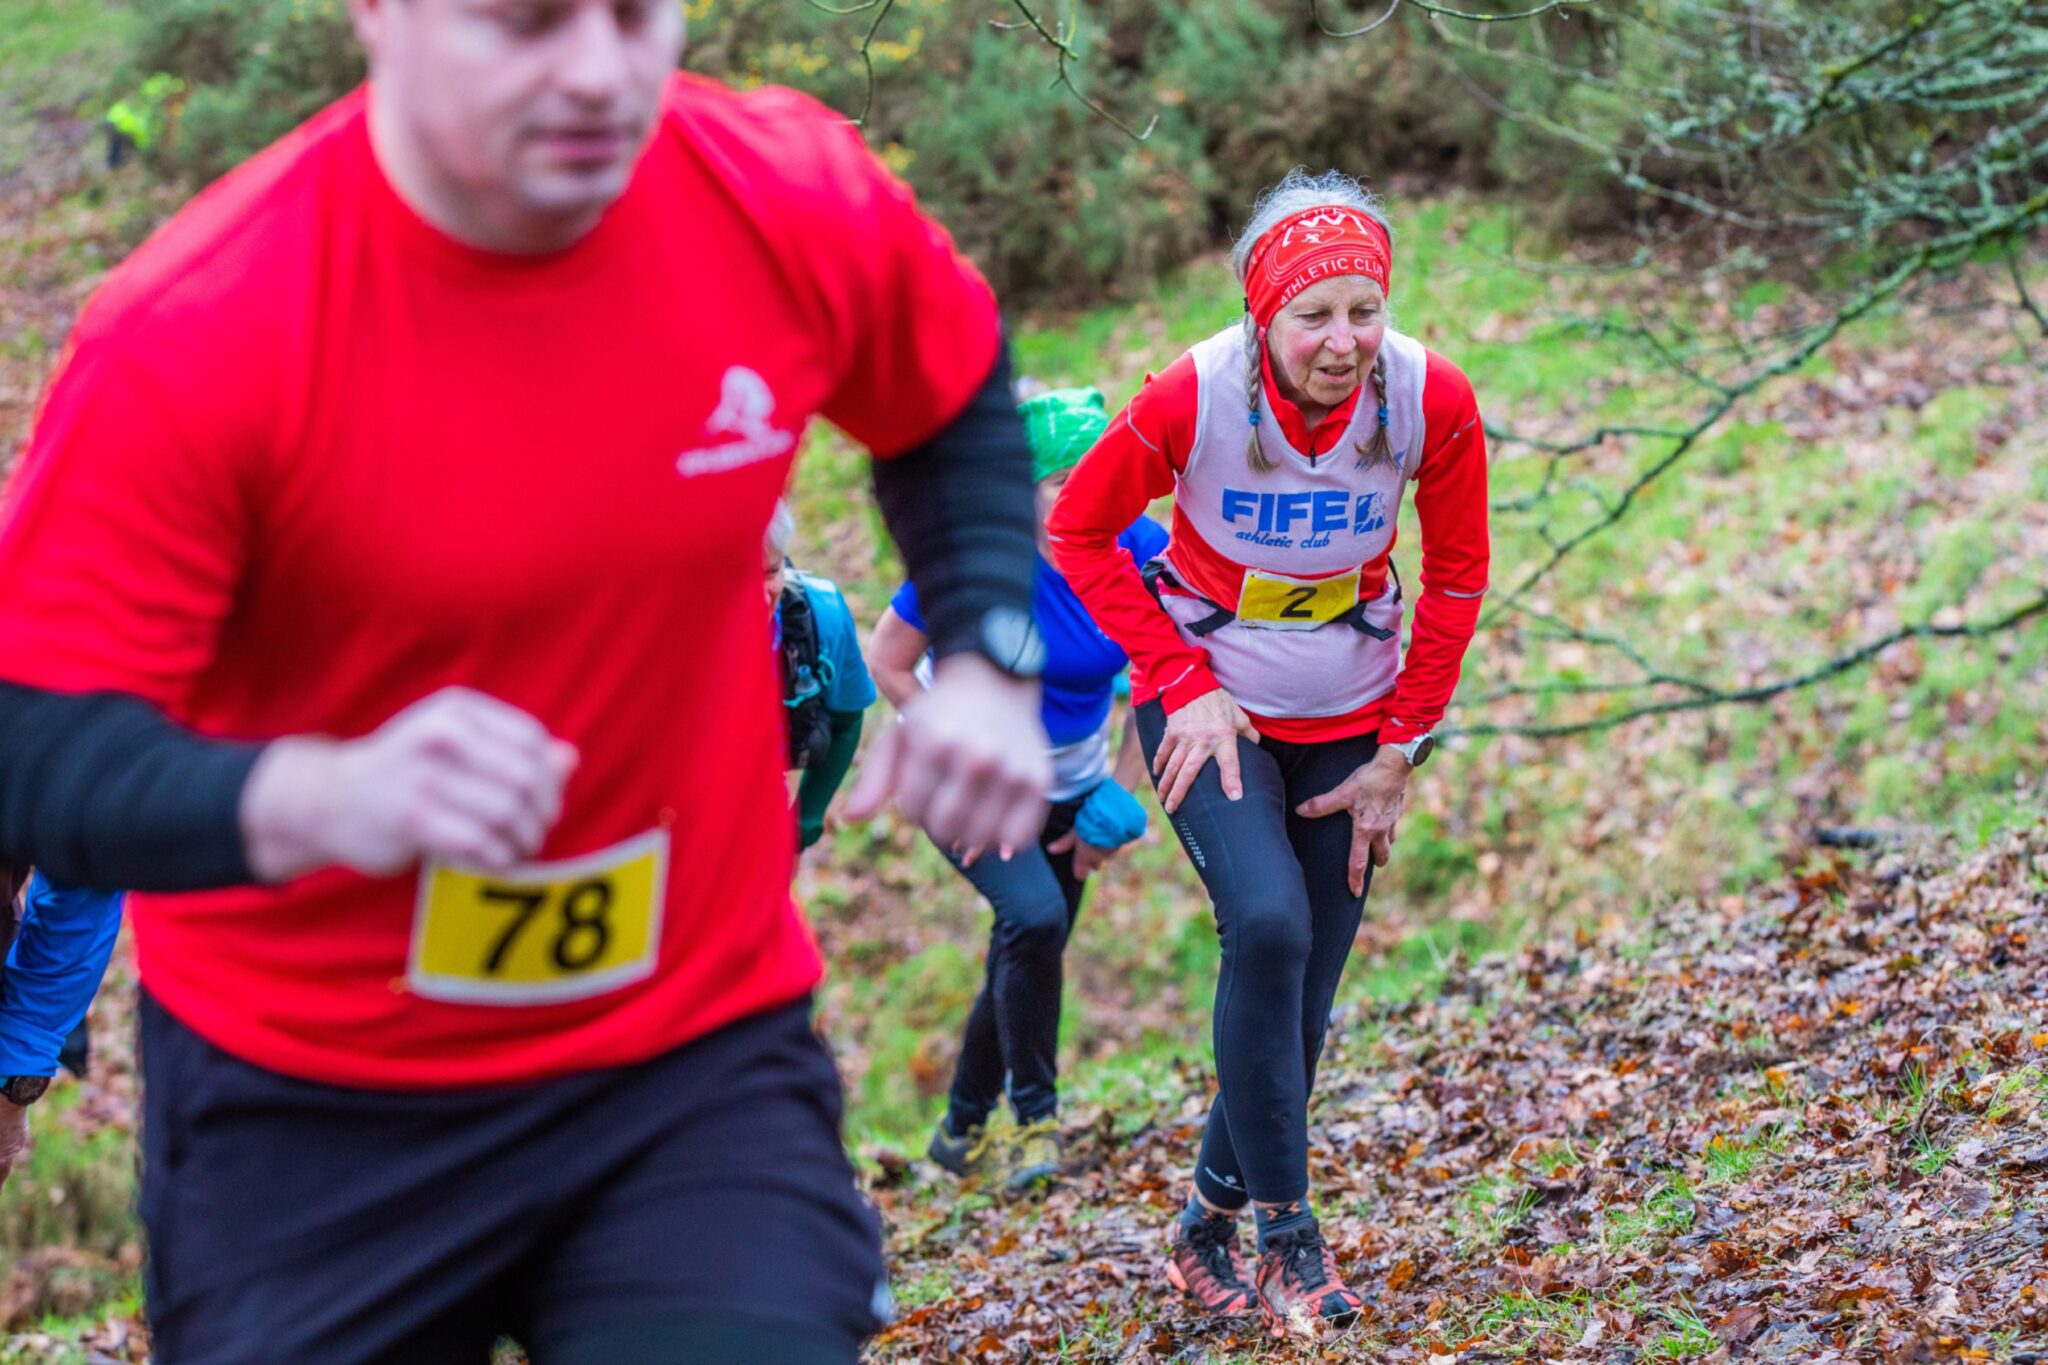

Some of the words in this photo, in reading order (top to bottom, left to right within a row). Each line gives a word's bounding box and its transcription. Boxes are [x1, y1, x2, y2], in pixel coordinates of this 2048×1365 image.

[1280, 257, 1349, 306] ATHLETIC
[1222, 487, 1350, 533] FIFE
[1235, 530, 1293, 548] athletic
[1300, 530, 1331, 548] club
[1279, 587, 1318, 618] 2
[477, 876, 614, 976] 78
